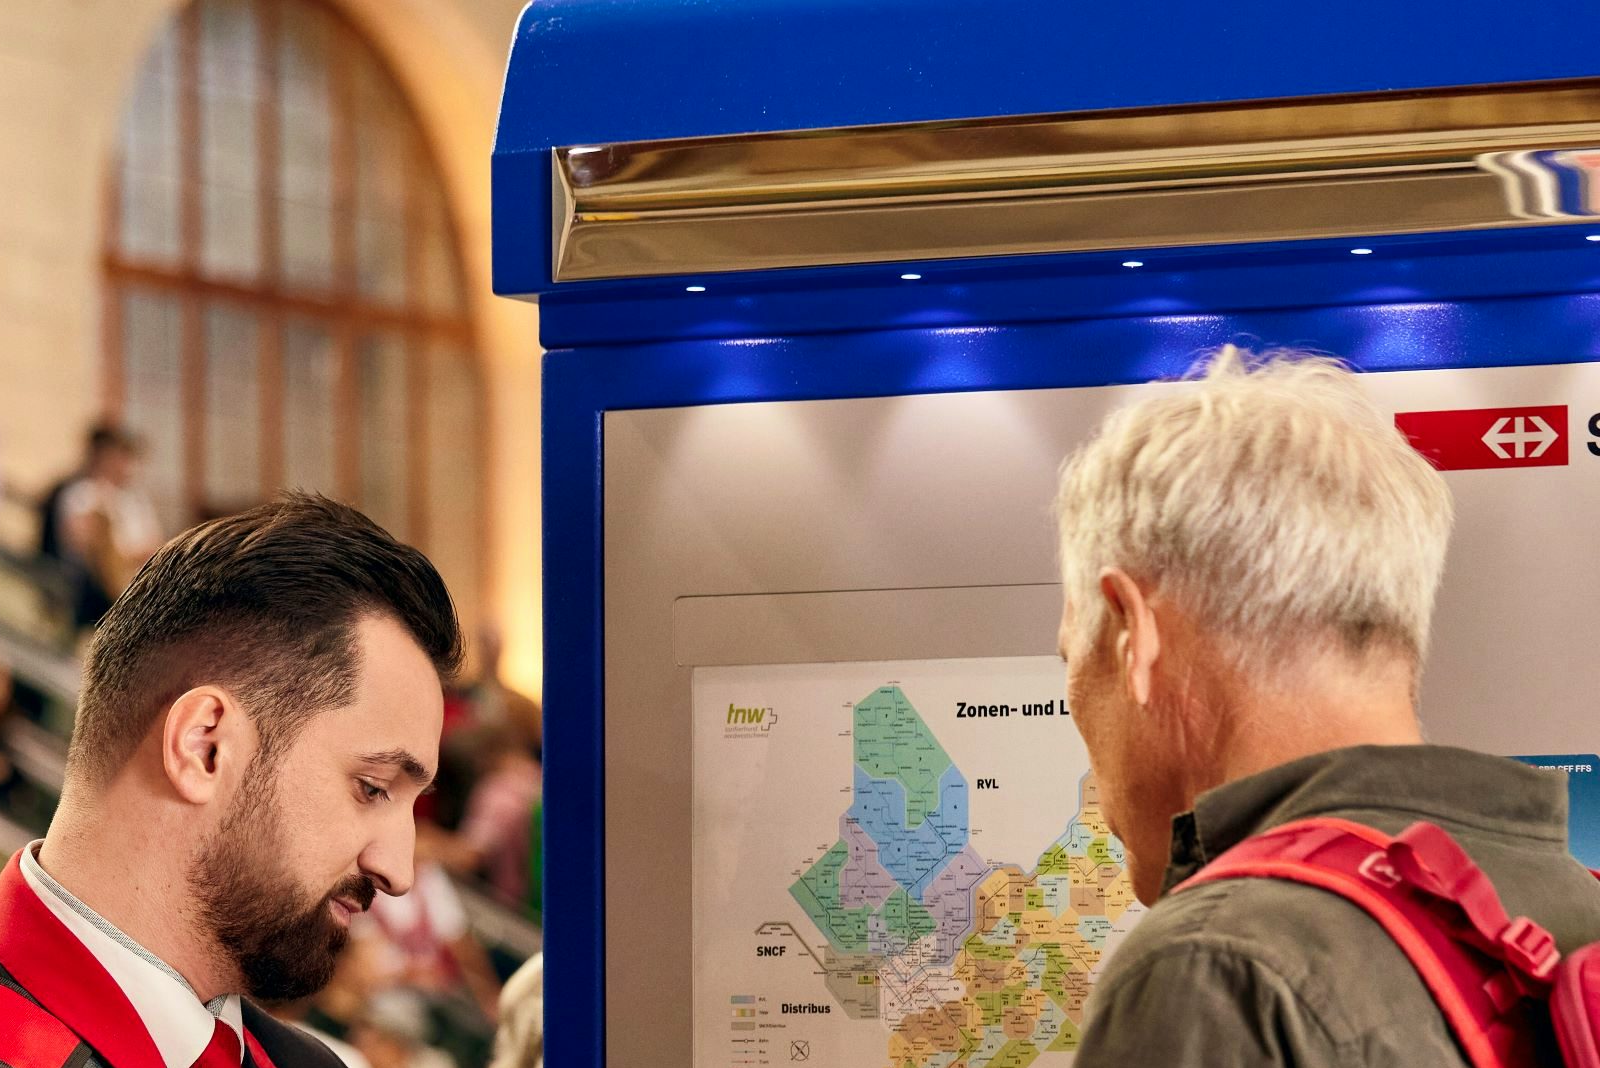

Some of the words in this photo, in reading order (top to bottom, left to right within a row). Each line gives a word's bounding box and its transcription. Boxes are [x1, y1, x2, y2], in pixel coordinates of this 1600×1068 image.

[727, 703, 765, 724] tnw
[956, 702, 1018, 718] Zonen-
[1022, 699, 1054, 716] und
[1575, 764, 1592, 773] FFS
[977, 778, 999, 790] RVL
[756, 946, 786, 957] SNCF
[781, 1003, 831, 1014] Distribus
